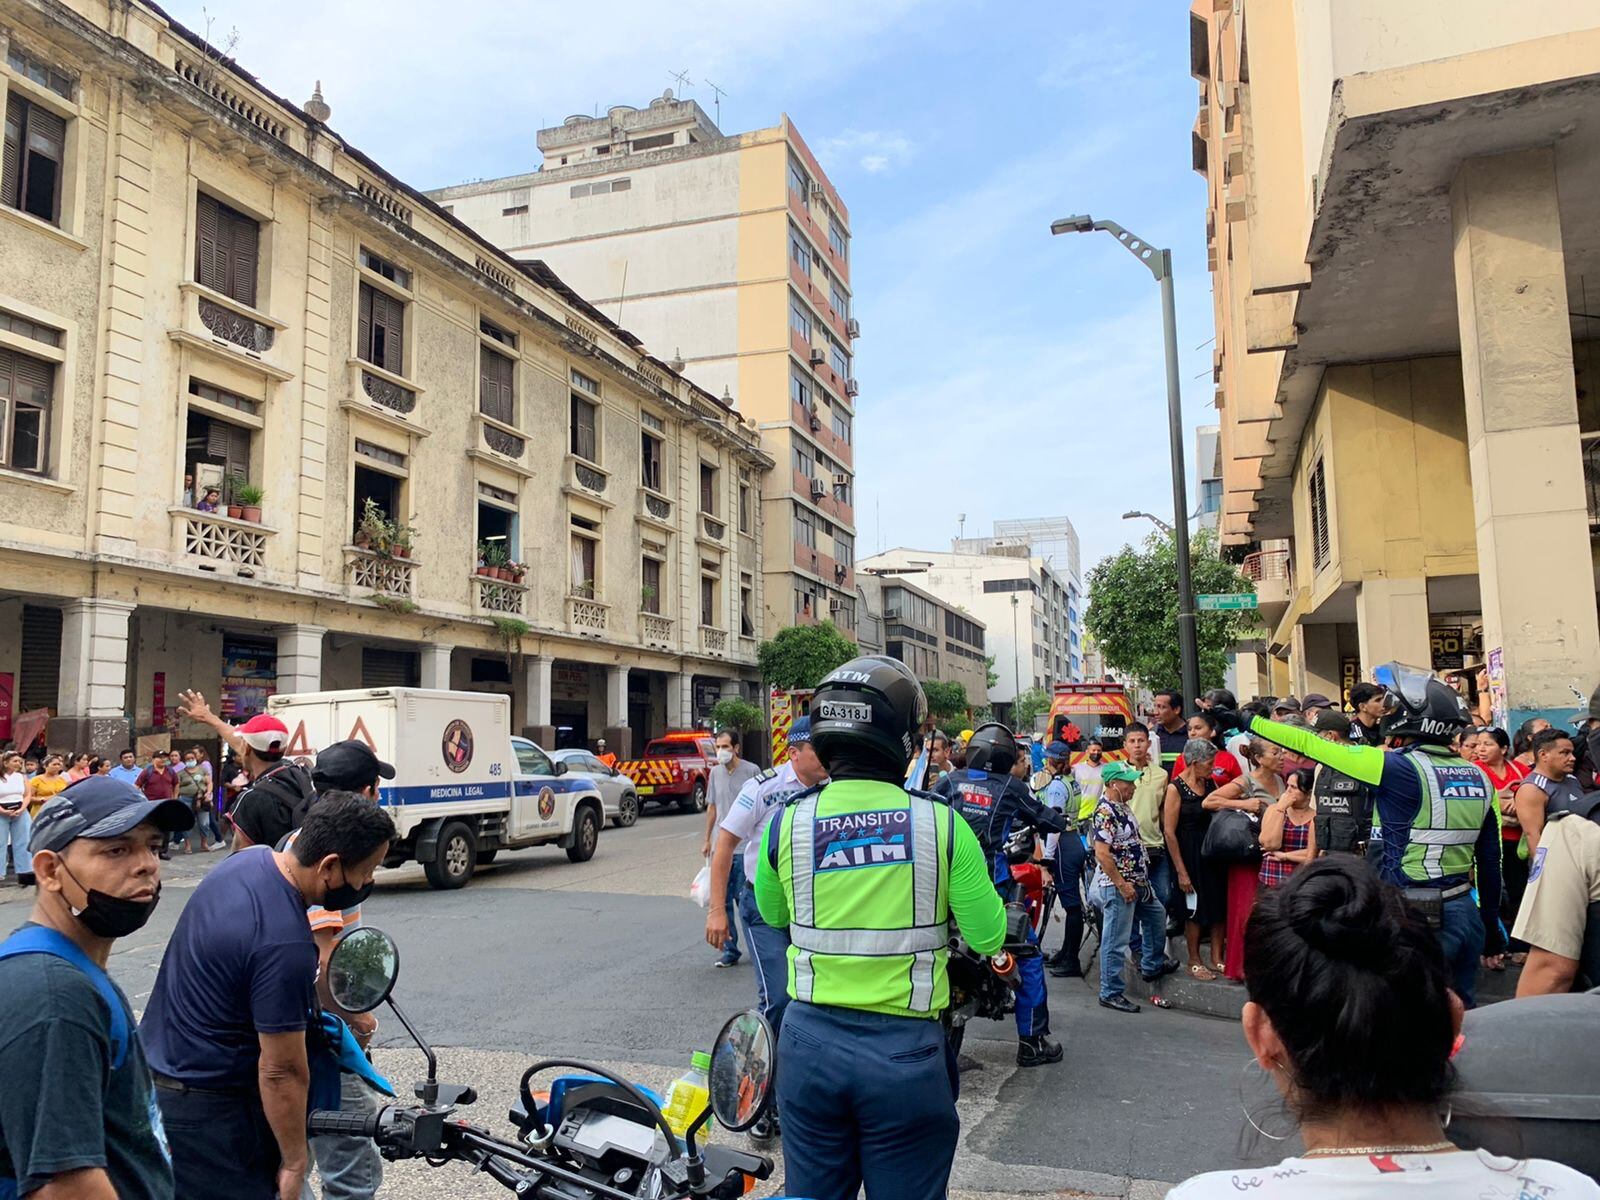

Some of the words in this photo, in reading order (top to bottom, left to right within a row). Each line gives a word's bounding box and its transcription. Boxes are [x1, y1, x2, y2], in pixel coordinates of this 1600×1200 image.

[827, 670, 871, 683] ATM
[822, 705, 868, 720] GA-318J
[489, 763, 502, 776] 485
[1435, 767, 1480, 776] TRANSITO
[430, 787, 463, 799] MEDICINA
[464, 786, 484, 796] LEGAL
[818, 811, 907, 832] TRANSITO
[819, 834, 907, 868] ATM
